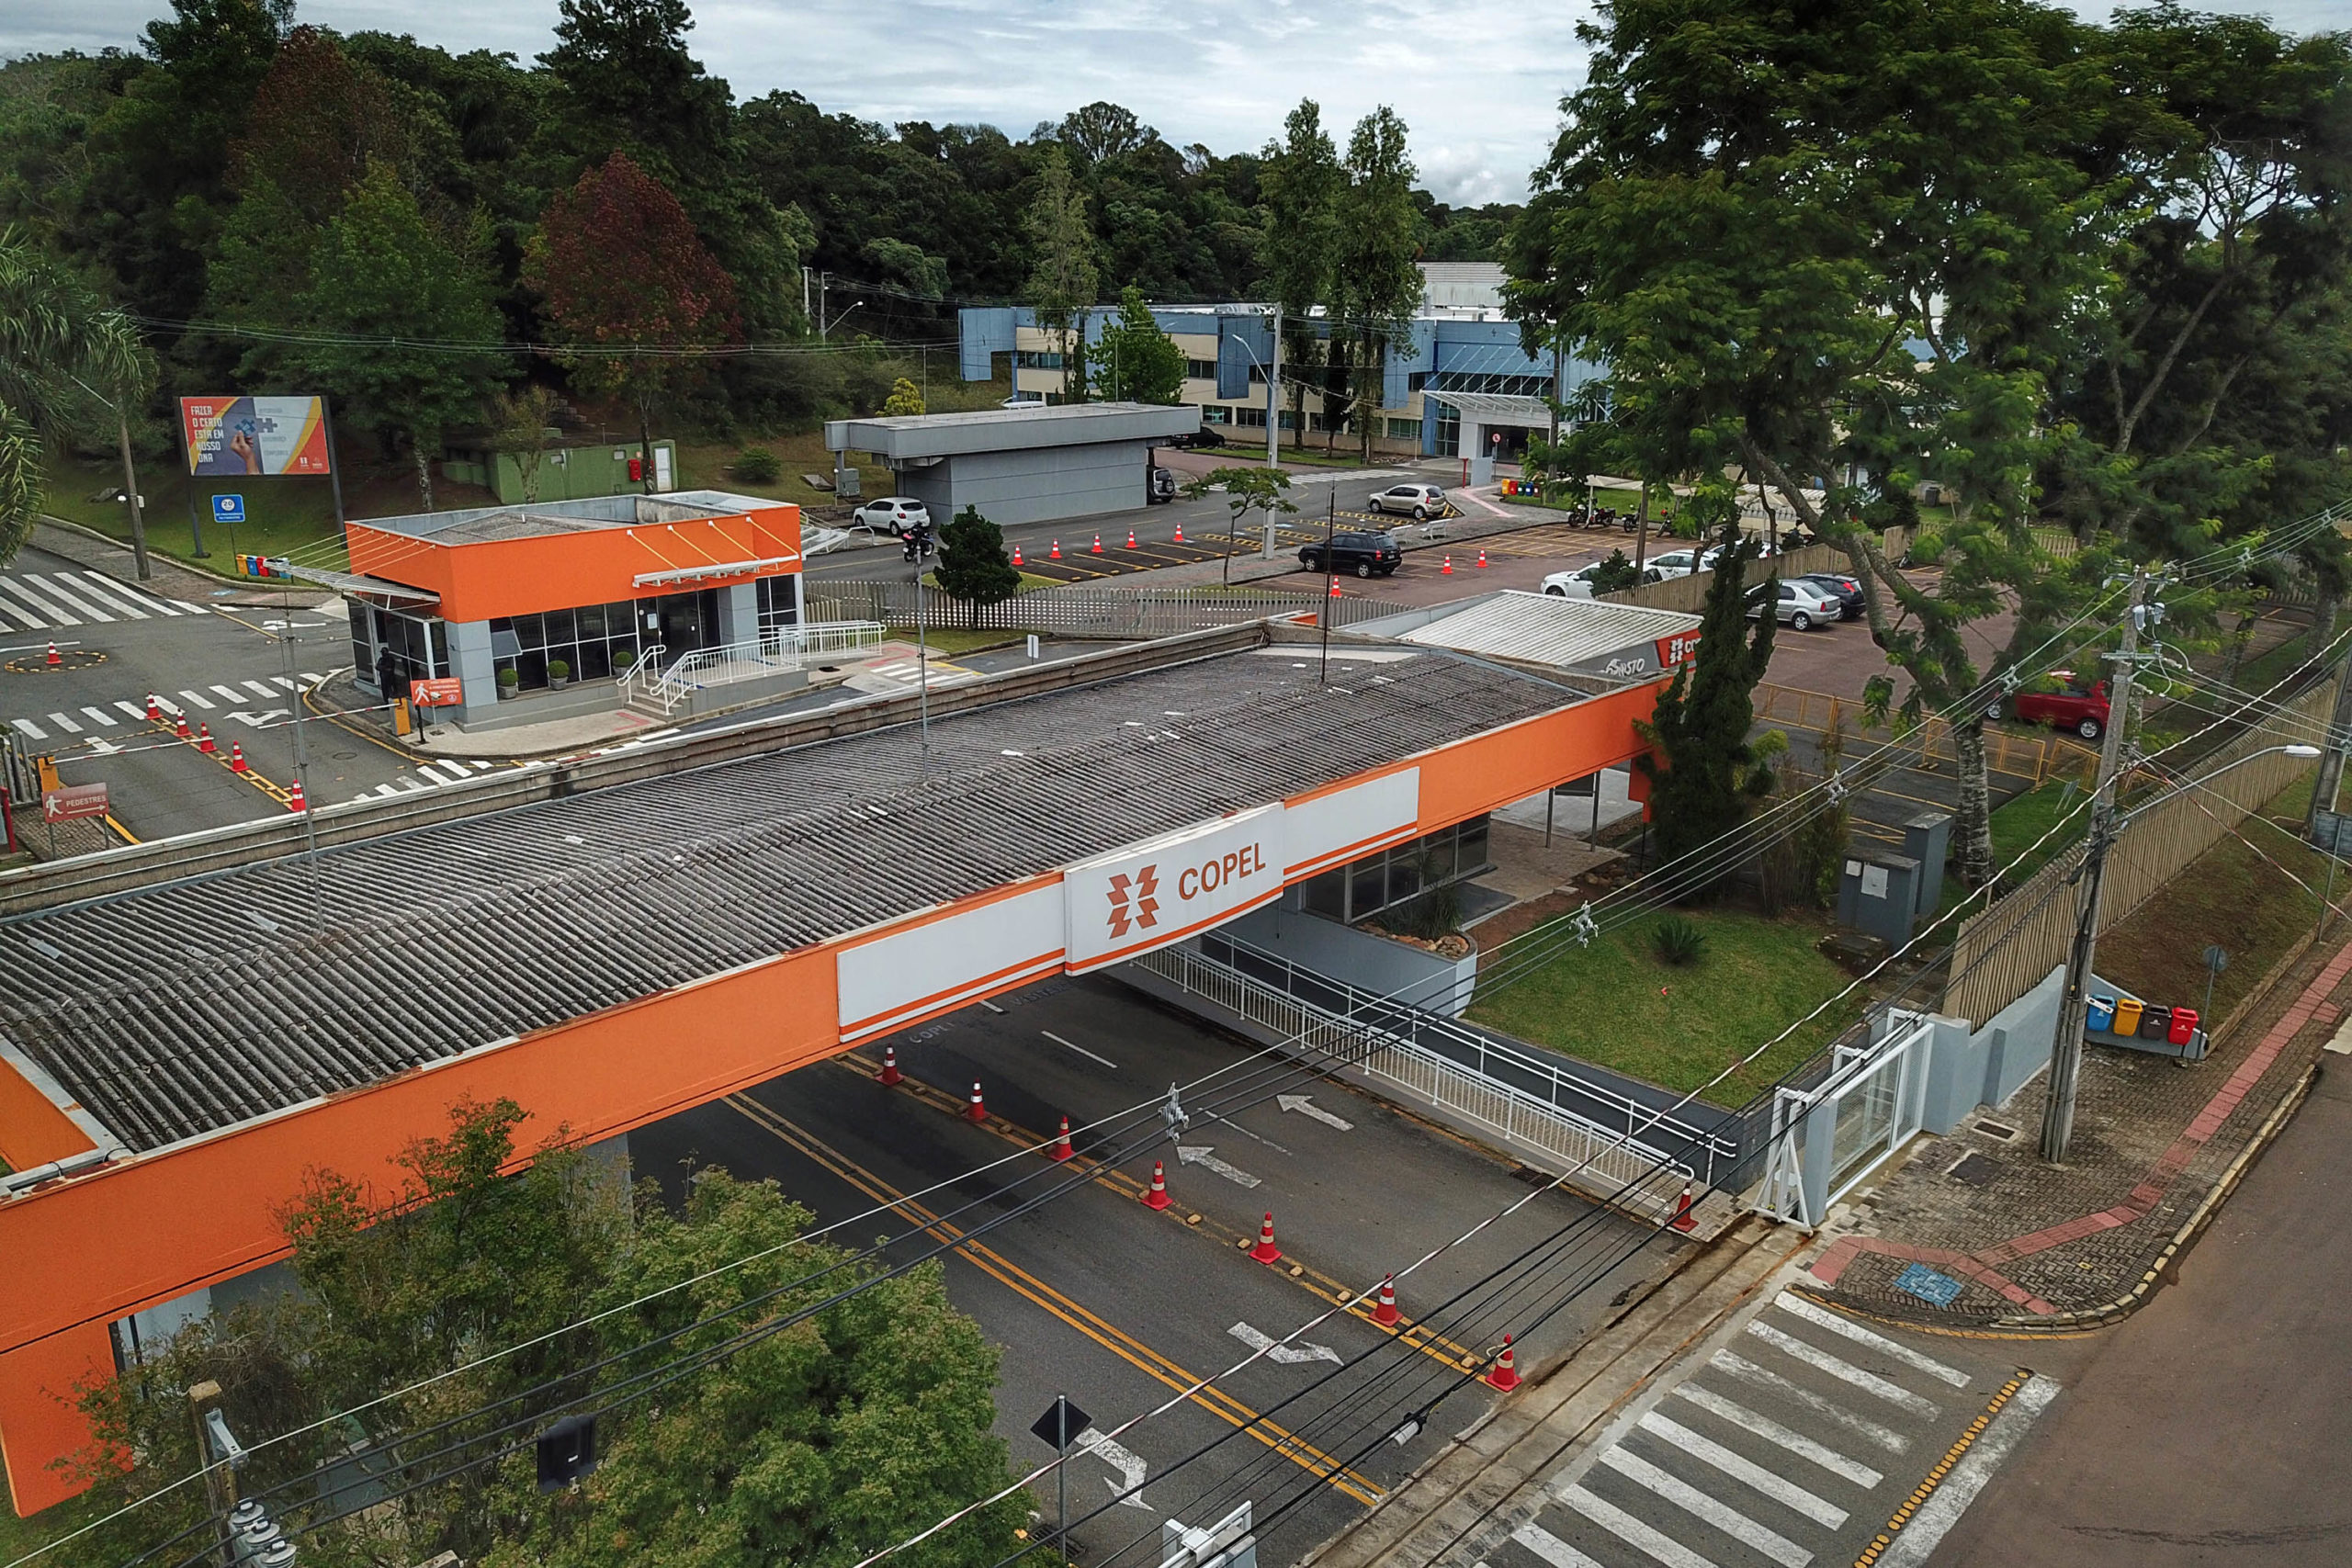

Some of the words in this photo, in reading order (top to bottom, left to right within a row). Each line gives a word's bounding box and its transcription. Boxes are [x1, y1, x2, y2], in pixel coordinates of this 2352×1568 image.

[190, 405, 213, 416] FAZER
[192, 417, 198, 428] O
[199, 417, 223, 428] CERTO
[213, 428, 224, 439] EM
[196, 441, 221, 451] NOSSO
[198, 453, 214, 463] DNA
[65, 795, 107, 807] PEDESTRES
[1178, 842, 1266, 901] COPEL
